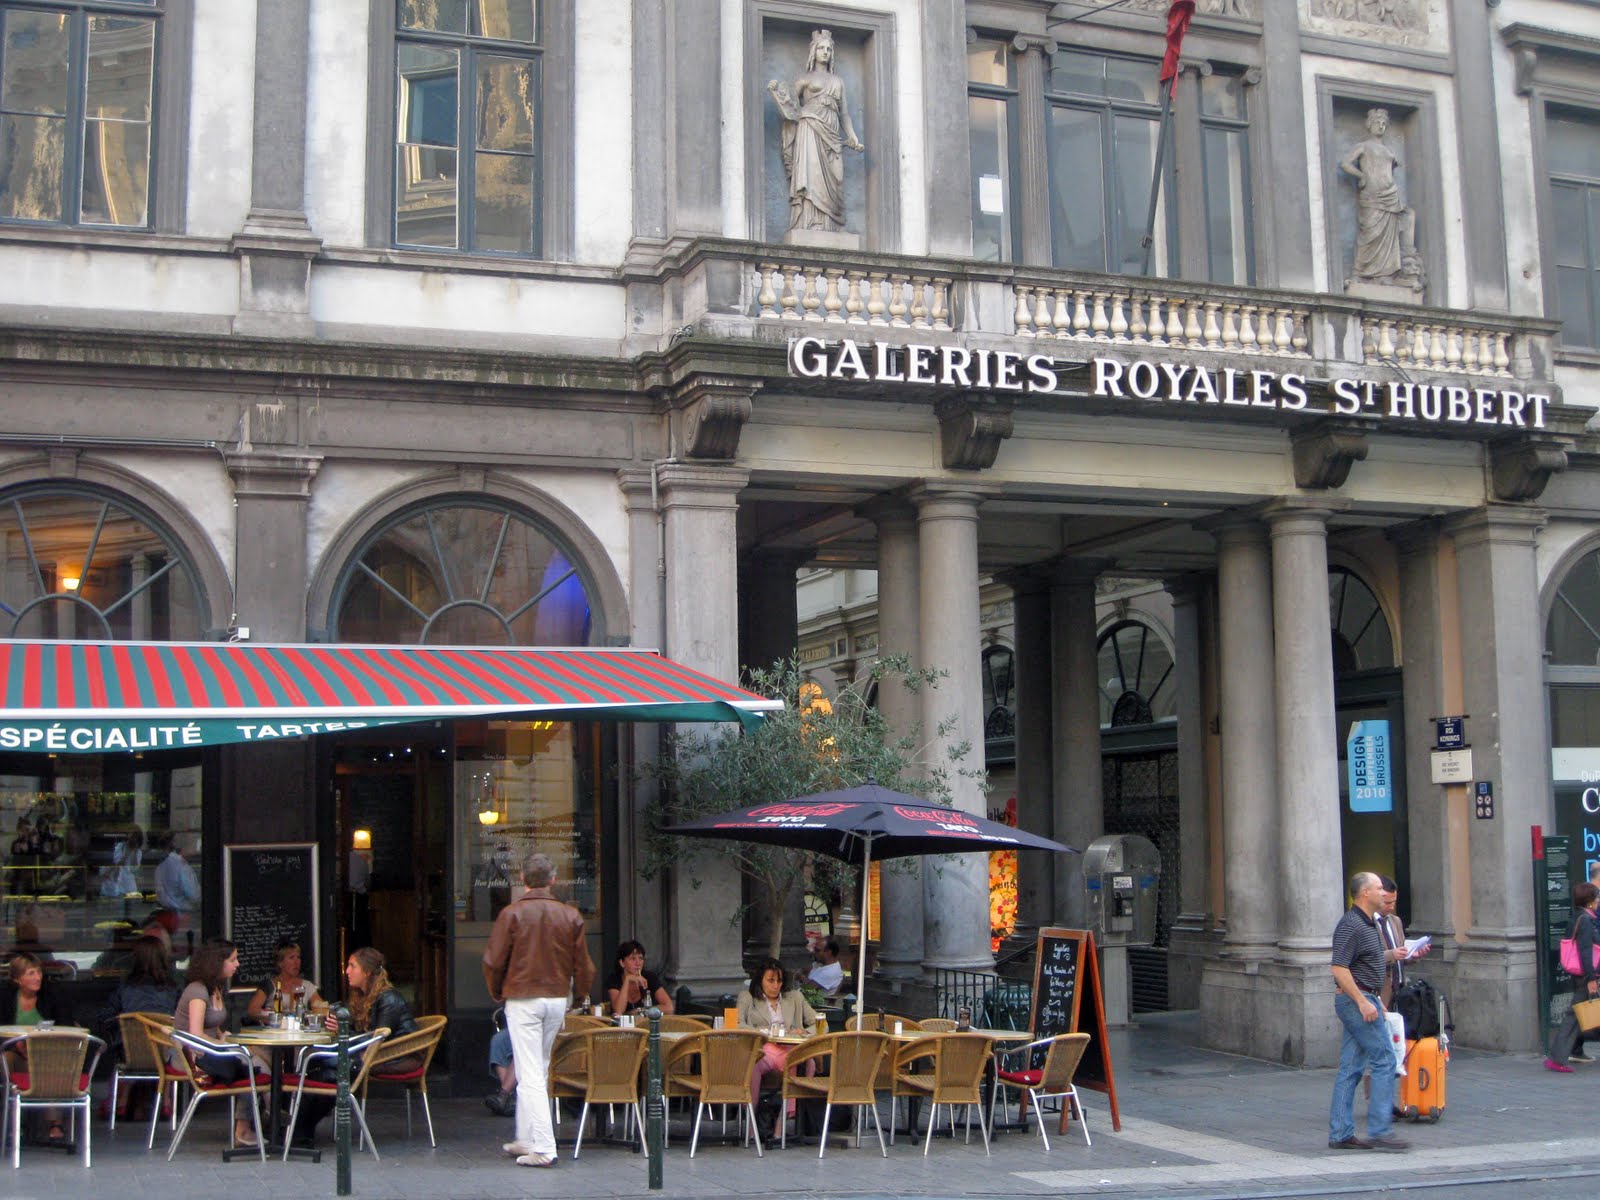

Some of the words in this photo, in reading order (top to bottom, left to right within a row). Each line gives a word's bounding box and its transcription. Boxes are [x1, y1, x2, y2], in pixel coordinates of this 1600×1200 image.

[792, 336, 1058, 394] GALERIES
[1093, 357, 1308, 410] ROYALES
[1388, 381, 1551, 428] HUBERT
[0, 722, 203, 750] SPÉCIALITÉ
[1354, 735, 1367, 787] DESIGN
[1365, 735, 1376, 786] SEPTEMBER
[1375, 735, 1386, 786] BRUSSELS
[1356, 787, 1386, 799] 2010
